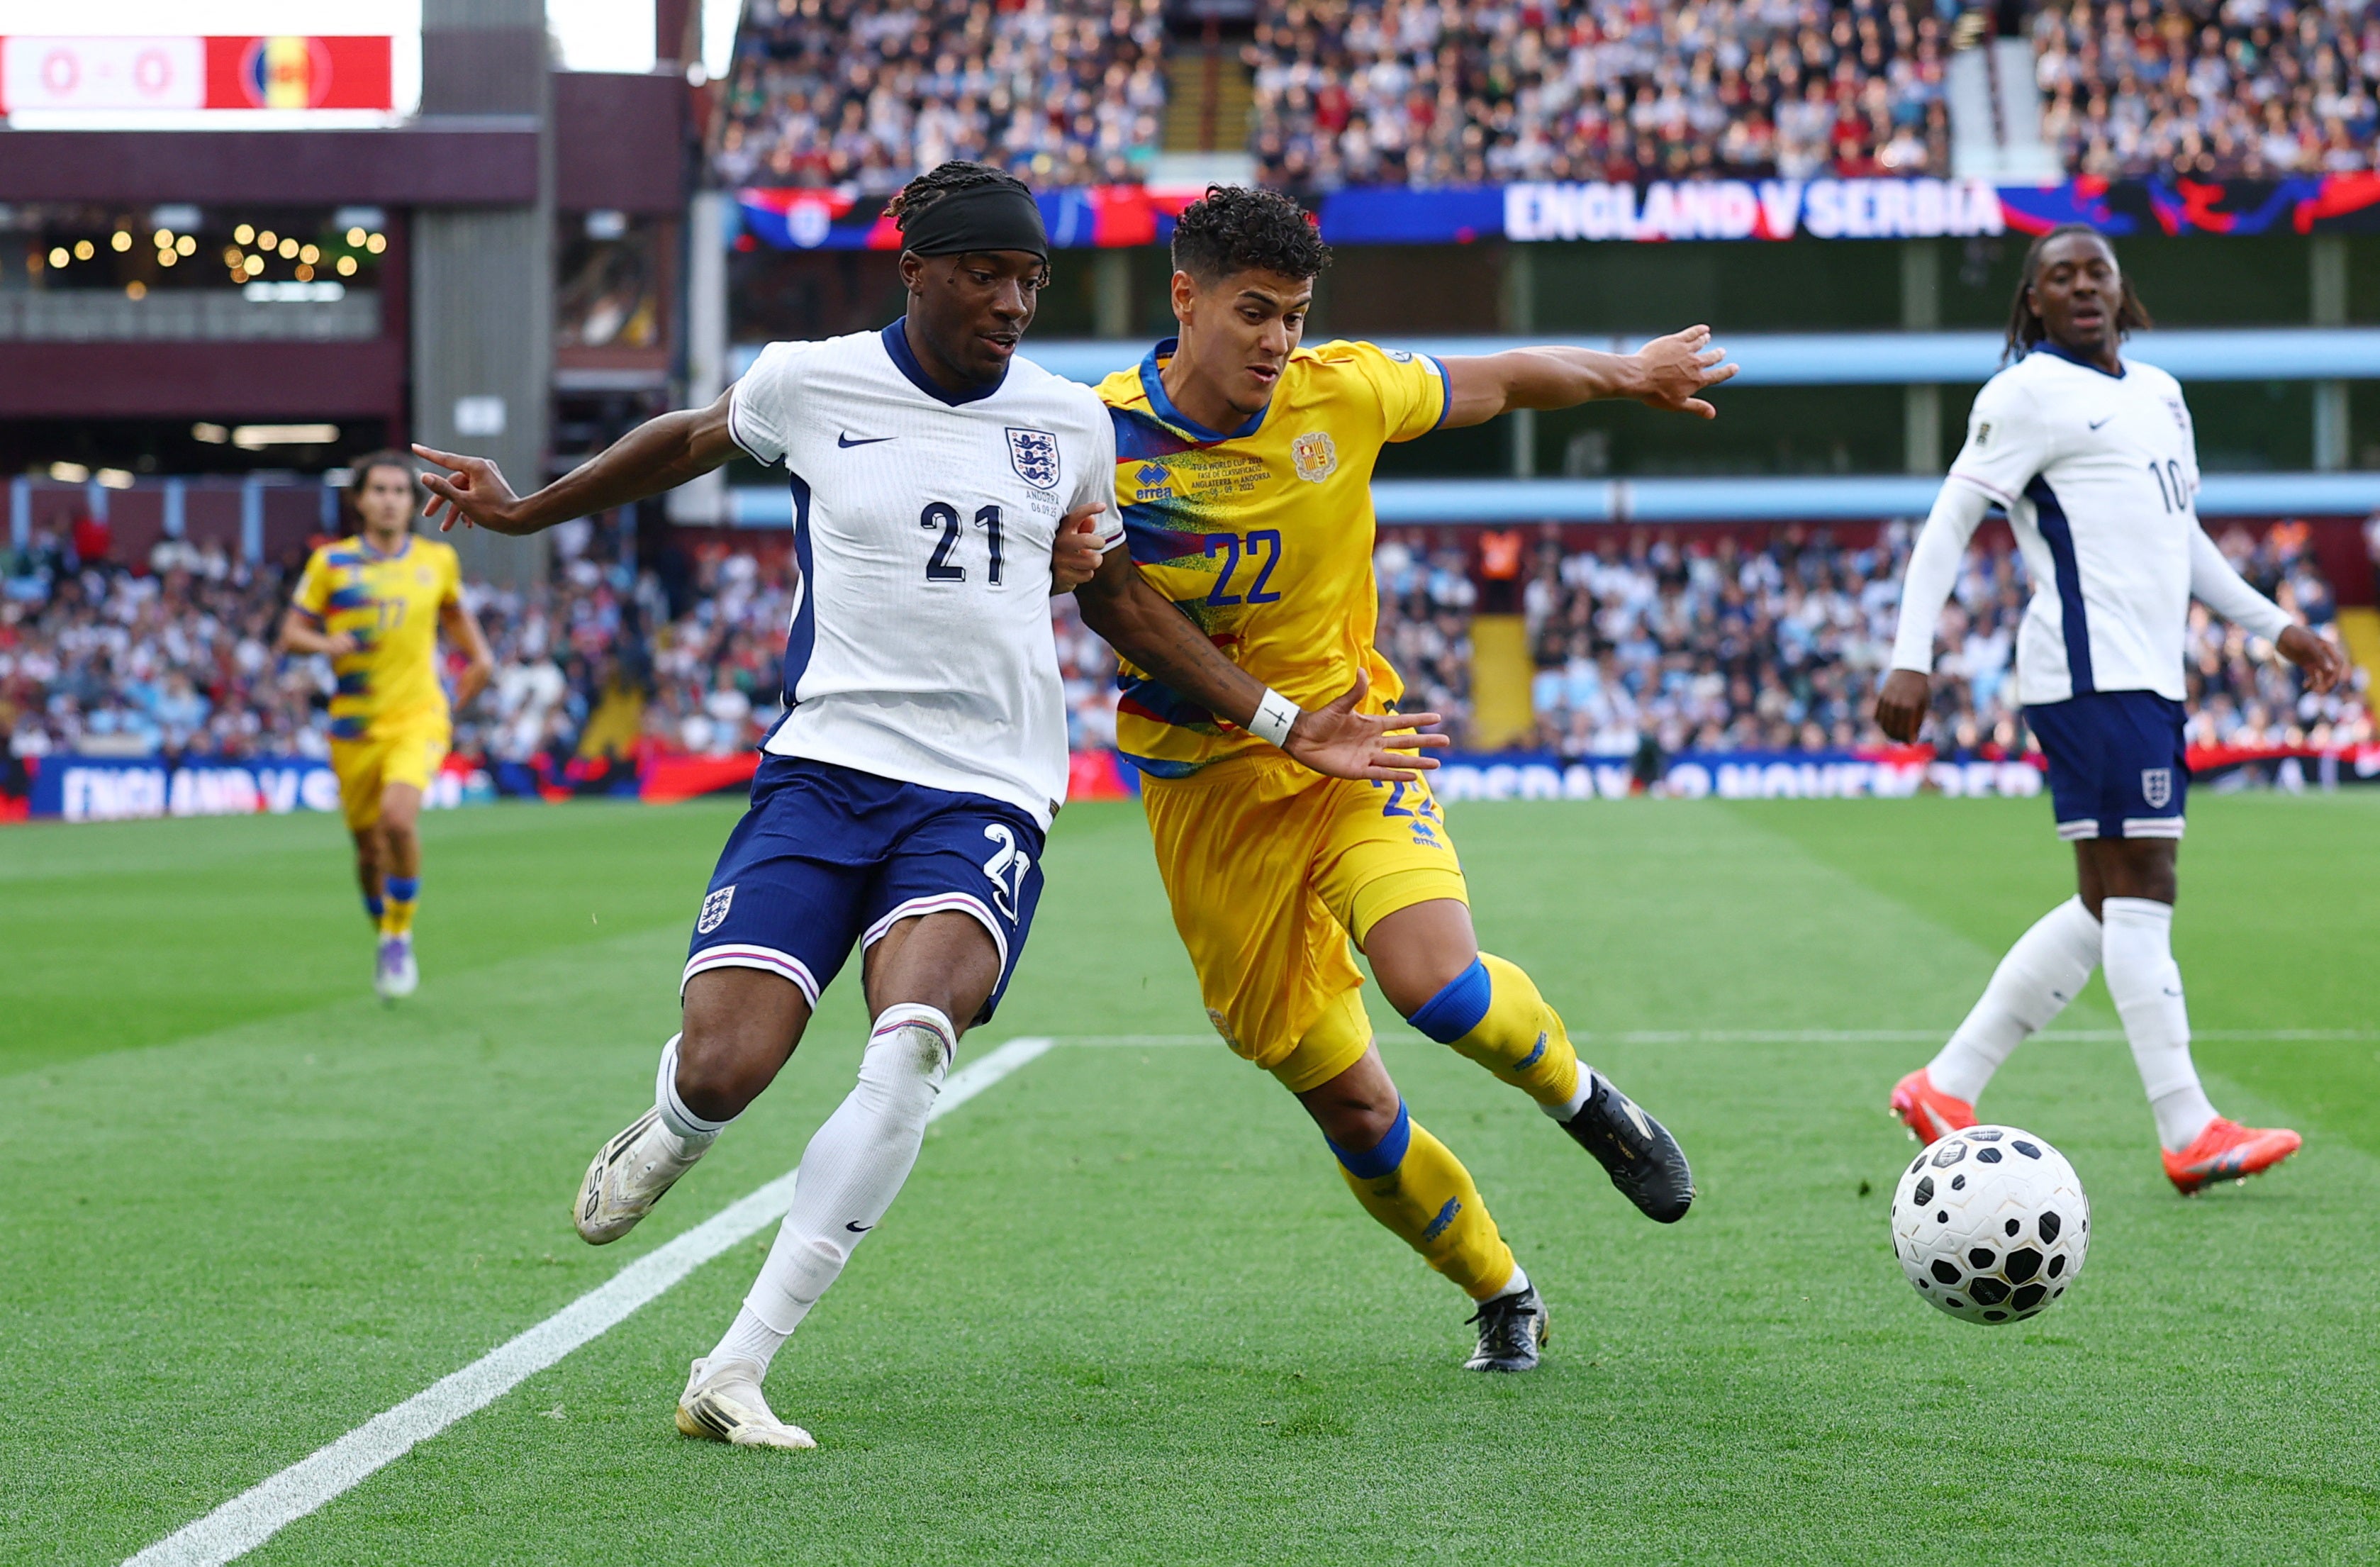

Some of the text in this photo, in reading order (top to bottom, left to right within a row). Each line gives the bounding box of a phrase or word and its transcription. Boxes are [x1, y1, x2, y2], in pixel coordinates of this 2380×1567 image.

[1504, 177, 2005, 241] ENGLAND V SERBIA
[1192, 479, 1232, 489] ANGLATERRA
[1241, 472, 1271, 483] ANDORRA
[1209, 460, 1232, 470] WORLD
[1233, 458, 1246, 467] CUP
[2148, 459, 2187, 515] 10
[1026, 490, 1059, 506] ANDORRA
[920, 501, 1005, 586] 21
[1205, 529, 1281, 607] 22
[62, 767, 257, 823] ENGLAND
[983, 823, 1031, 927] 21
